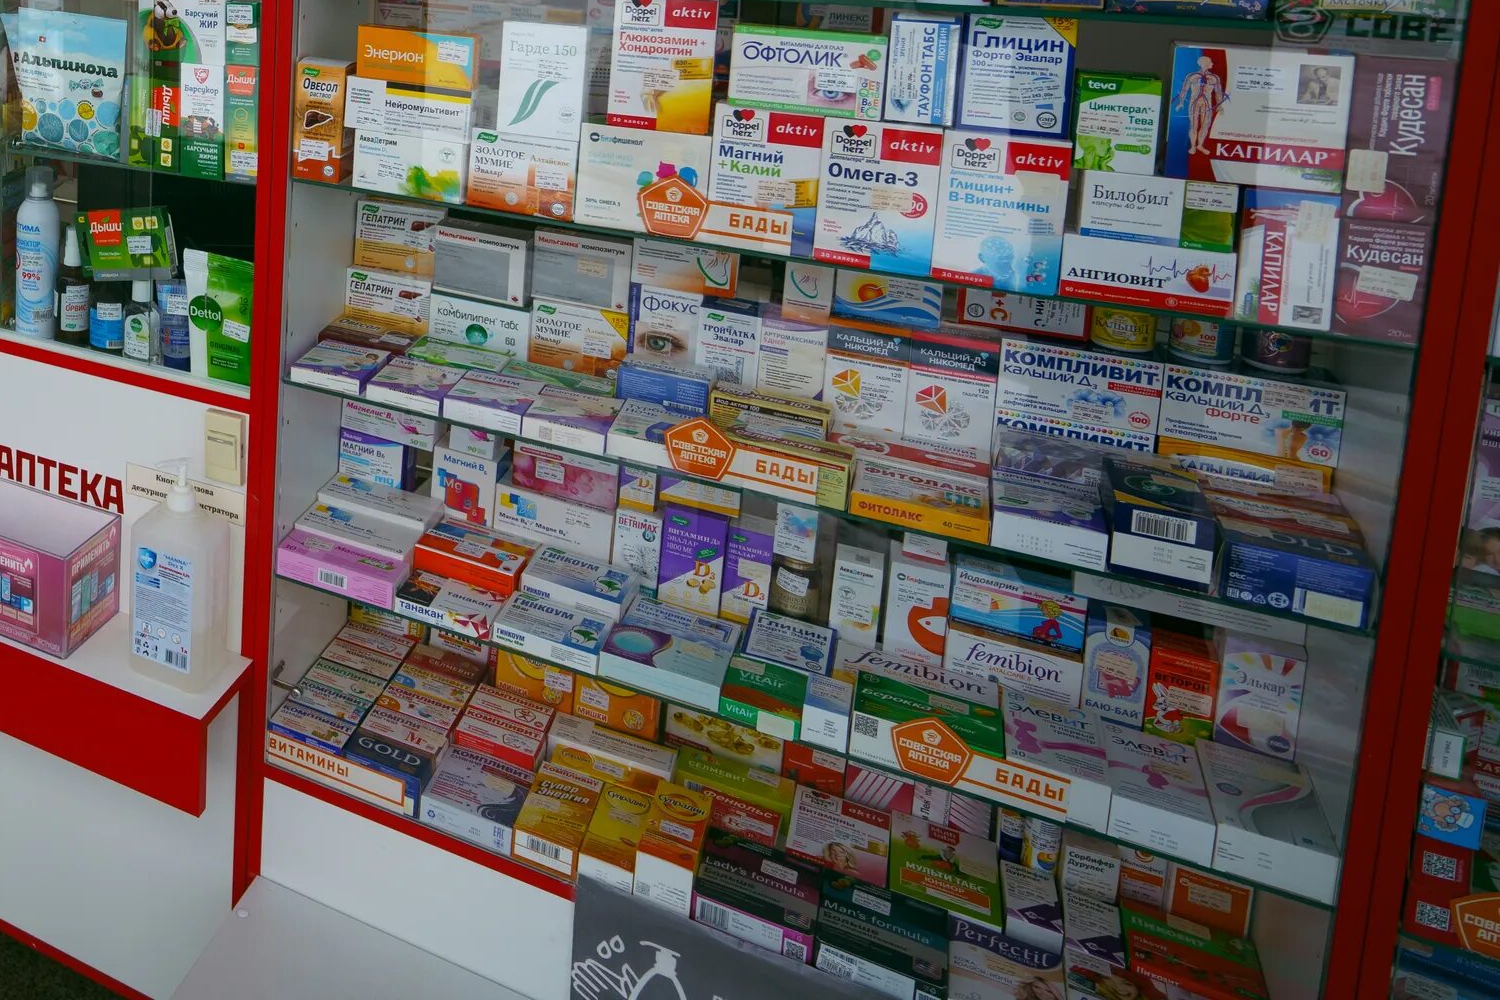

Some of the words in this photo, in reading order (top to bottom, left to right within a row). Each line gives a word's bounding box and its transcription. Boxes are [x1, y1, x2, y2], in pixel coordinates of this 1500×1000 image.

[185, 9, 218, 19] Барсучий
[625, 6, 657, 18] Doppel
[672, 7, 711, 19] aktiv
[199, 19, 218, 29] ЖИР
[619, 33, 698, 46] Глюкозамин
[972, 31, 1064, 53] Глицин
[364, 45, 424, 63] Энерион
[510, 41, 549, 54] Гарде
[554, 45, 577, 56] 150
[618, 43, 692, 56] Хондроитин
[743, 42, 842, 68] ОФТОЛИК
[972, 49, 1011, 61] Форте
[1016, 52, 1062, 64] Эвалар
[21, 51, 118, 79] Альпинола
[184, 84, 219, 96] Барсукор
[1087, 79, 1116, 91] teva
[385, 100, 460, 116] Нейромультивит
[1389, 74, 1426, 156] Кудесан
[726, 120, 760, 135] Doppel
[1129, 115, 1153, 126] Тева
[776, 125, 817, 137] aktiv
[836, 135, 872, 151] Doppel
[890, 141, 934, 155] aktiv
[475, 146, 525, 160] ЗОЛОТОЕ
[719, 146, 784, 164] Магний
[956, 149, 996, 163] Doppel
[1016, 154, 1063, 168] aktiv
[1216, 143, 1328, 165] КАПИЛАР
[474, 166, 502, 176] Эвалар
[475, 156, 513, 169] МУМИЕ
[828, 163, 918, 187] Омега-3
[950, 178, 1014, 195] Глицин+
[1093, 184, 1169, 206] Билобил
[645, 200, 700, 217] СОВЕТСКАЯ
[361, 213, 405, 227] ГЕПАТРИН
[654, 211, 690, 224] АПТЕКА
[729, 213, 788, 235] БАДЫ
[90, 220, 122, 235] Дыши
[438, 229, 476, 243] Мильгамма
[479, 238, 519, 250] композитум
[538, 235, 579, 248] Мильгамма
[581, 243, 625, 256] композитум
[1346, 244, 1423, 266] Кудесан
[22, 271, 41, 281] 99%
[1068, 266, 1166, 289] АНГИОВИТ
[1263, 231, 1283, 312] КАПИЛАР
[350, 280, 393, 296] ГЕПАТРИН
[190, 305, 221, 322] Dettol
[536, 316, 581, 331] ЗОЛОТОЕ
[536, 325, 570, 338] МУМИЕ
[703, 324, 756, 341] ТРОЙЧАТКА
[763, 330, 824, 346] АРТРОМАКСИМУМ
[845, 342, 889, 356] НИКОМЕД
[929, 357, 975, 371] НИКОМЕД
[1004, 348, 1154, 386] КОМПЛИВИТ
[1206, 407, 1260, 424] форте
[672, 439, 727, 459] СОВЕТСКАЯ
[680, 451, 716, 467] АПТЕКА
[756, 459, 815, 486] БАДЫ
[858, 500, 923, 523] ФИТОЛАКС
[618, 515, 657, 534] DETRIMAX
[514, 597, 574, 620] ГИНКОУМ
[968, 642, 1061, 683] femibion
[1235, 669, 1286, 695] Элькар
[726, 703, 752, 718] VitAir
[1085, 698, 1139, 719] БАЮ-БАЙ
[270, 737, 349, 778] ВИТАМИНЫ
[358, 735, 421, 767] GOLD
[900, 737, 962, 764] СОВЕТСКАЯ
[908, 750, 950, 770] АПТЕКА
[996, 767, 1064, 802] БАДЫ
[705, 856, 747, 878] Lady's
[750, 869, 804, 899] formula
[825, 899, 866, 923] Man's
[869, 912, 929, 945] formula
[955, 921, 1051, 968] Perfectil
